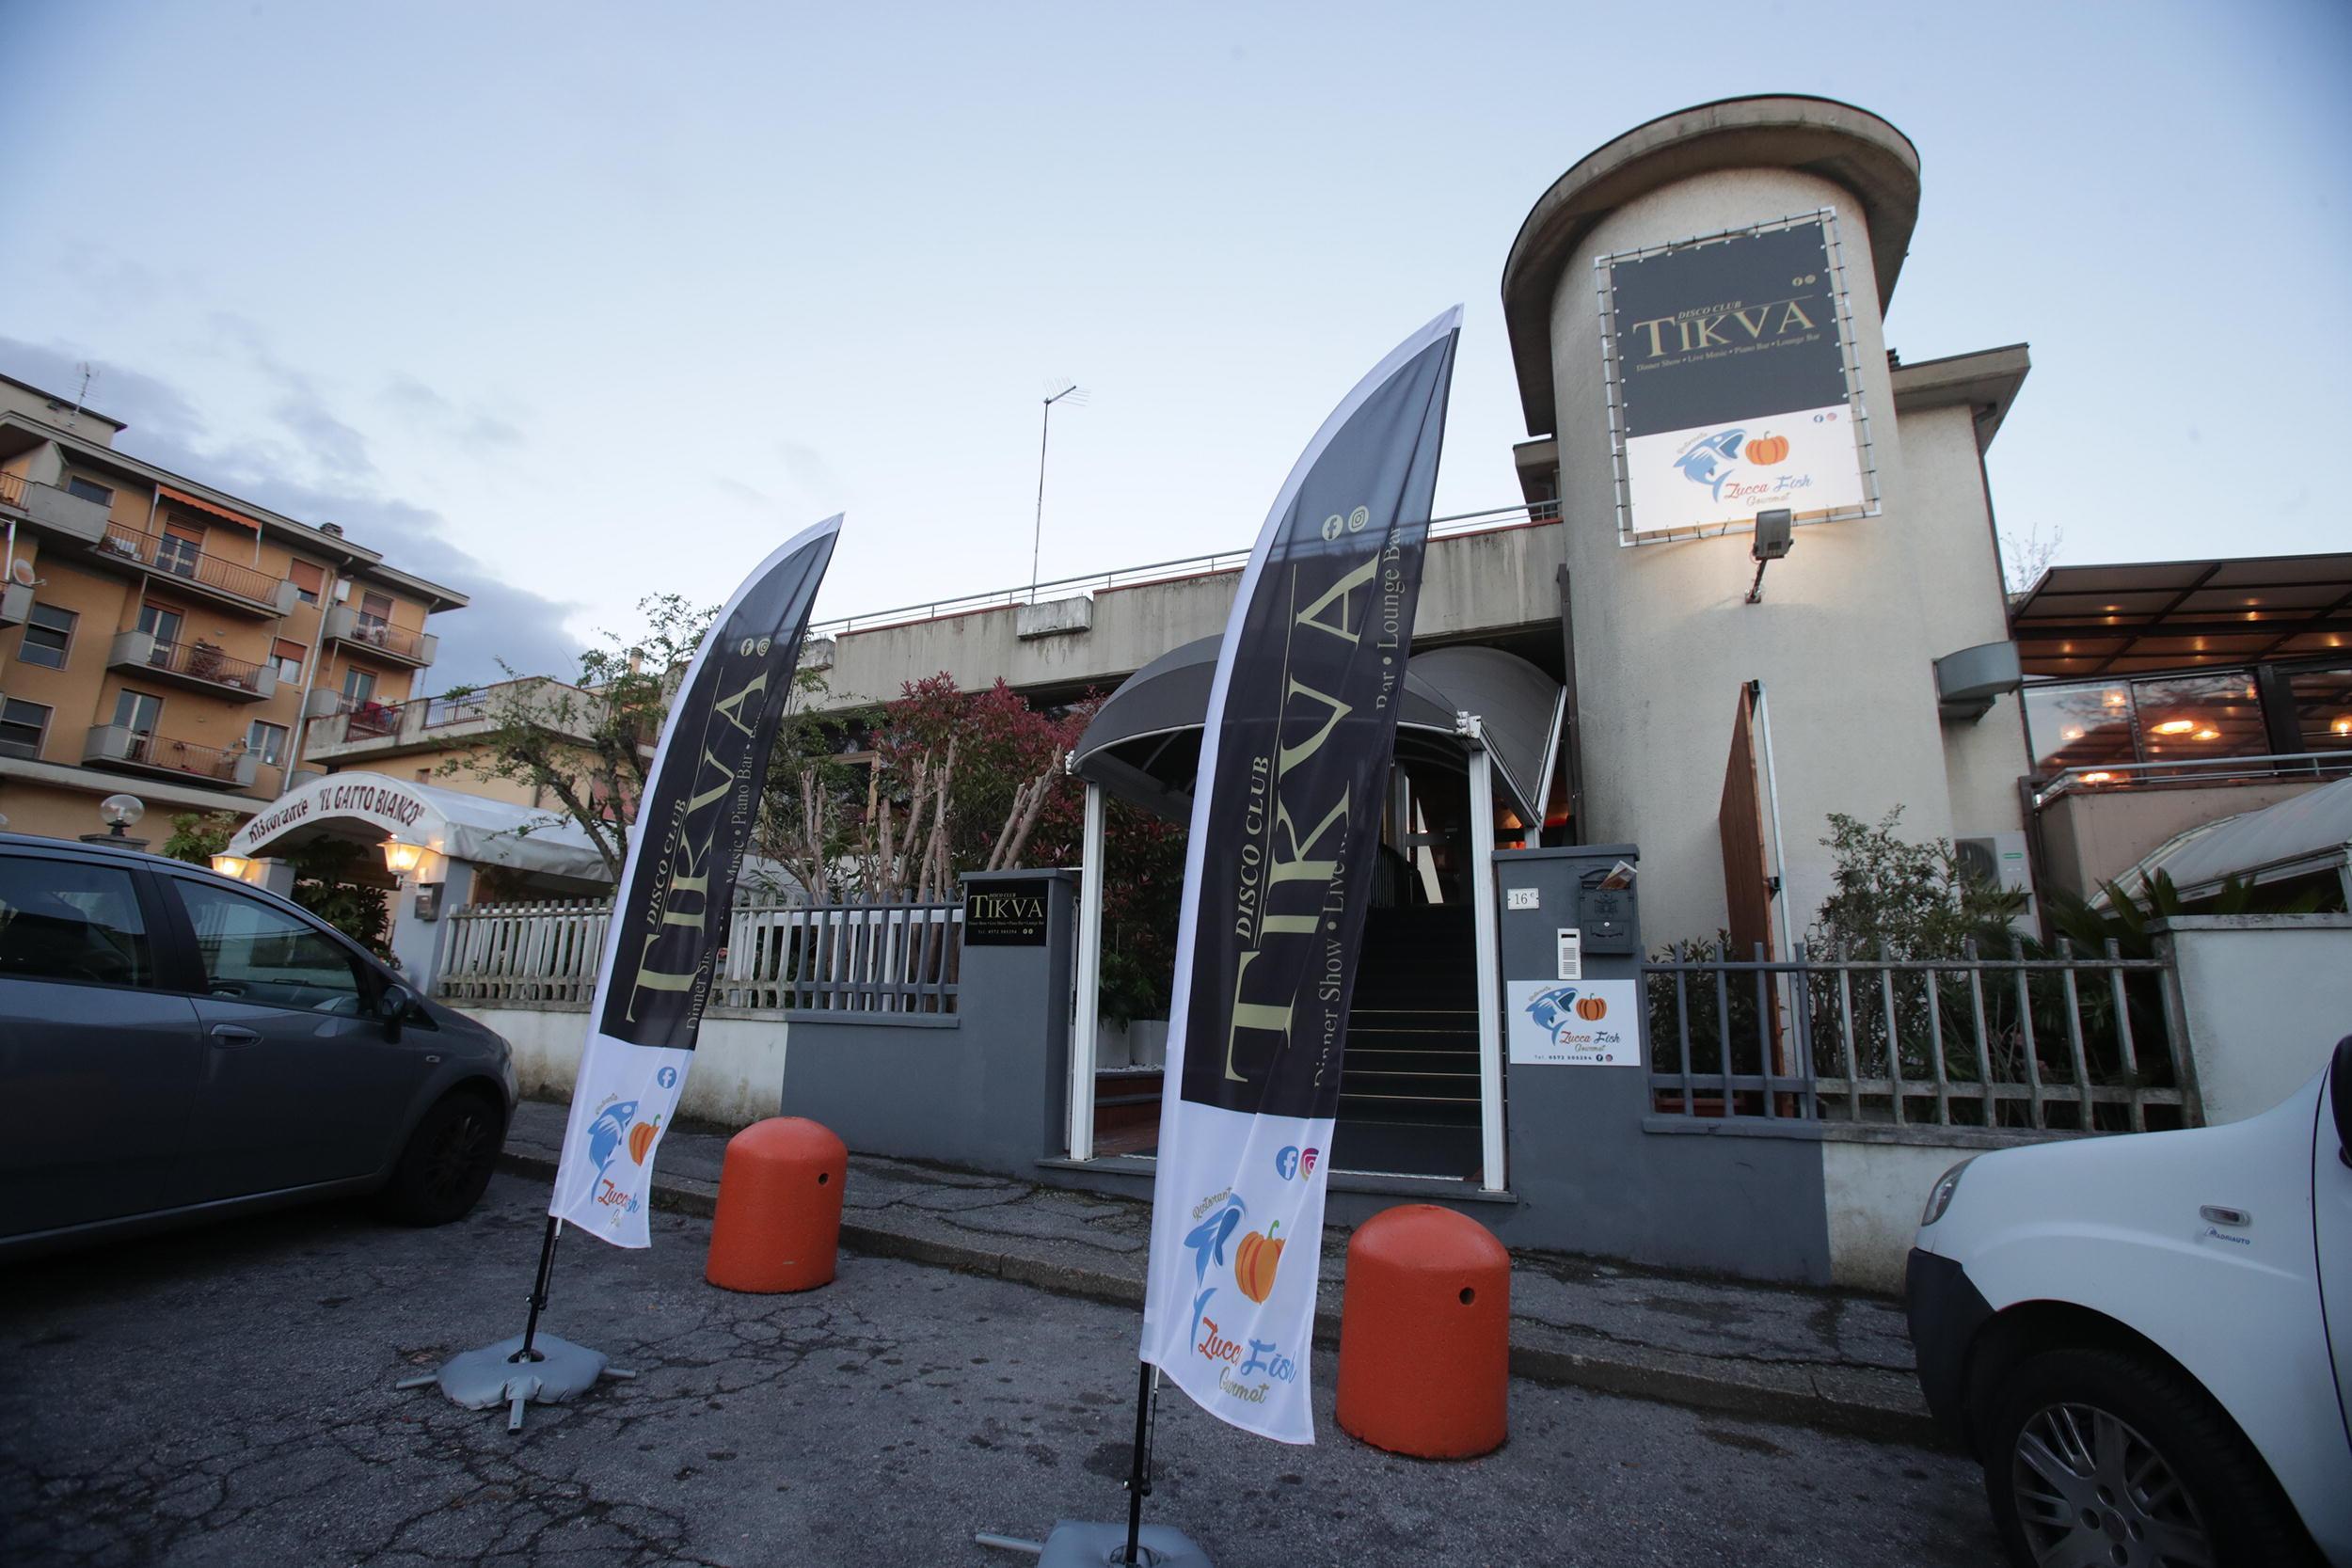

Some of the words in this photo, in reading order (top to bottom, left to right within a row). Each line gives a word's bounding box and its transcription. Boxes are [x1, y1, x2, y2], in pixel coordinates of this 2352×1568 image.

[1632, 300, 1816, 358] TIKVA
[1677, 305, 1710, 320] DISCO
[1712, 300, 1742, 314] CLUB
[1724, 482, 1770, 499] Zucca
[1773, 474, 1814, 493] Fish
[1382, 527, 1402, 565] Bar
[1377, 566, 1406, 649] Lounge
[737, 753, 753, 780] Bar
[334, 784, 375, 813] GATTO
[731, 783, 750, 826] Piano
[1224, 548, 1381, 1083] TIKVA
[1246, 755, 1269, 835] CLUB
[626, 670, 769, 1023] TIKVA
[646, 859, 669, 927] DISCO
[663, 798, 687, 856] CLUB
[969, 895, 1043, 919] TIKVA
[1235, 844, 1261, 940] DISCO
[1323, 861, 1345, 914] Live
[1318, 938, 1343, 1001] Show
[686, 977, 707, 1030] Dinner
[1559, 1030, 1591, 1044] Zucca
[1593, 1030, 1622, 1044] Fish
[1192, 1186, 1232, 1222] Ristorant
